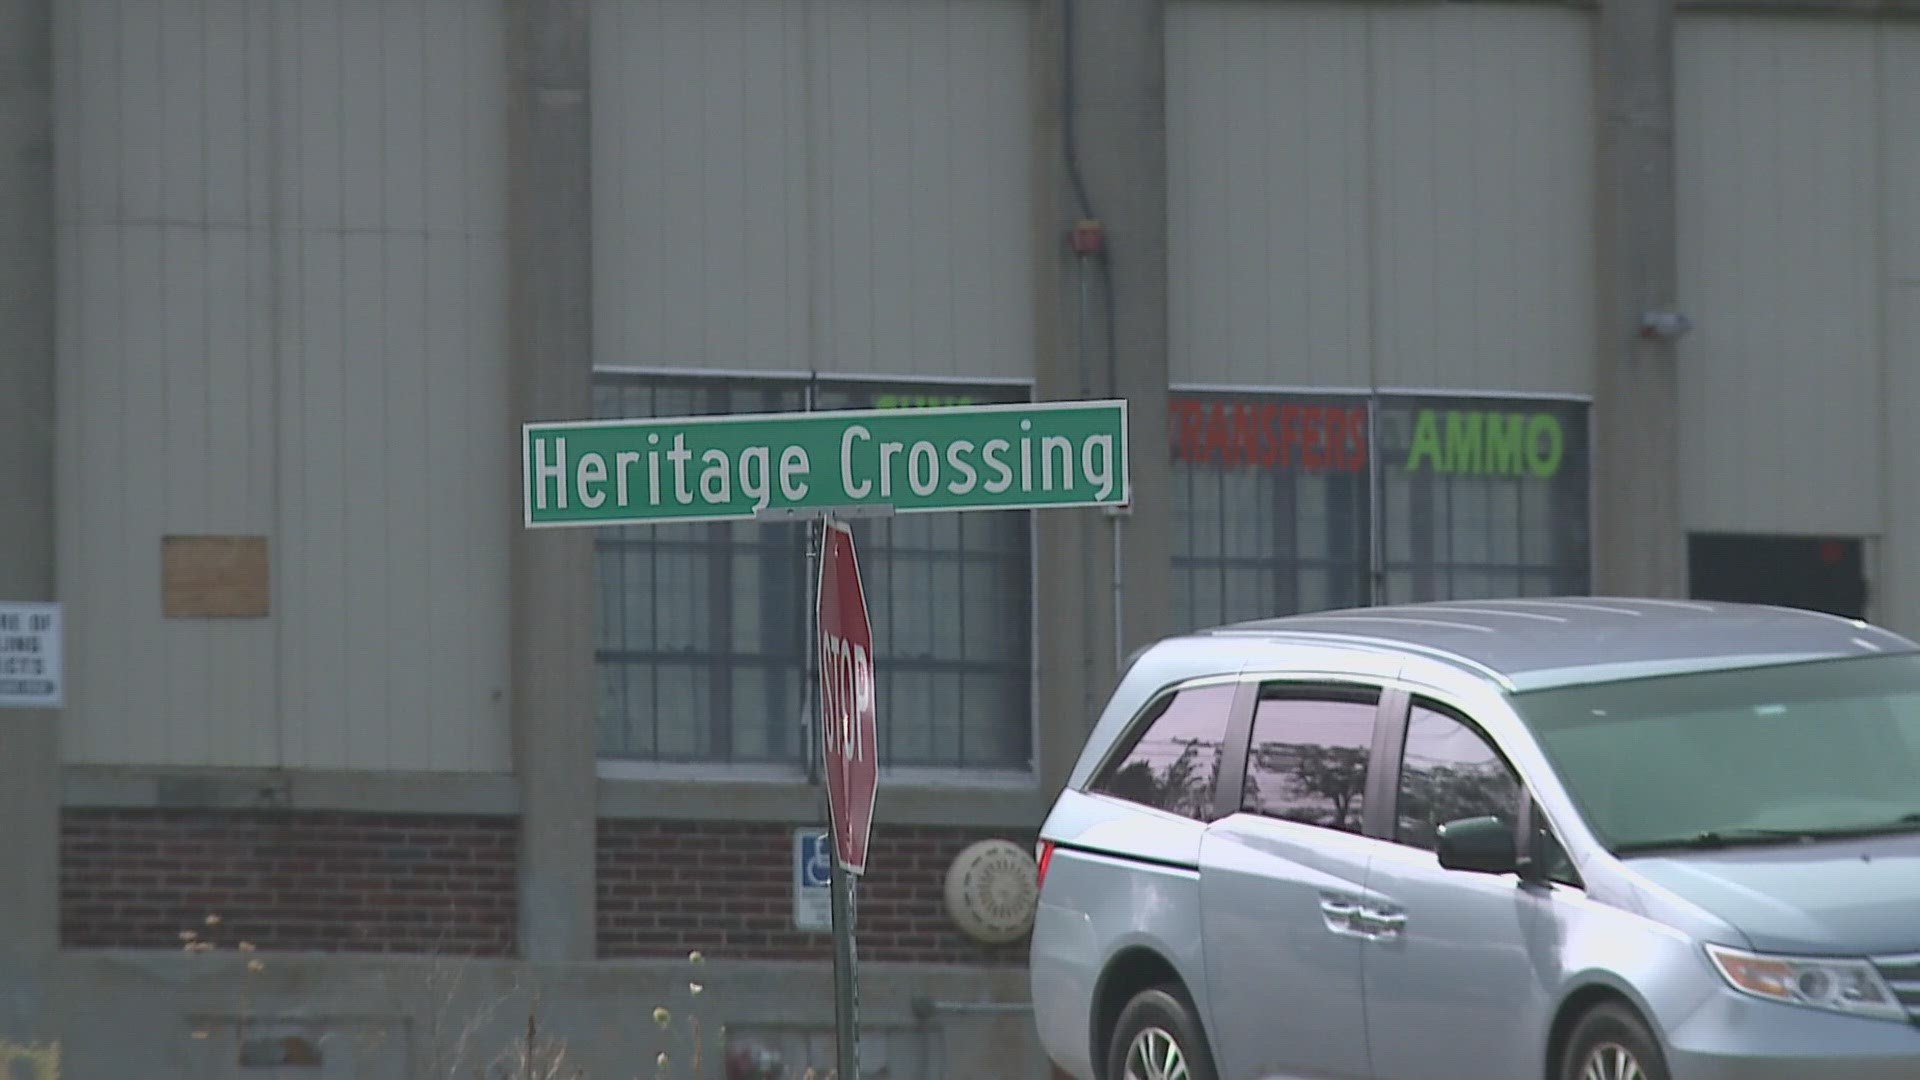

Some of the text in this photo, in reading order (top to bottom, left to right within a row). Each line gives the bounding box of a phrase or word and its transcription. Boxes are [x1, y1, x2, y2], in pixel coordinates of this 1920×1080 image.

[535, 418, 1113, 512] Heritage Crossing
[1406, 408, 1564, 478] AMMO
[823, 629, 869, 763] STOP
